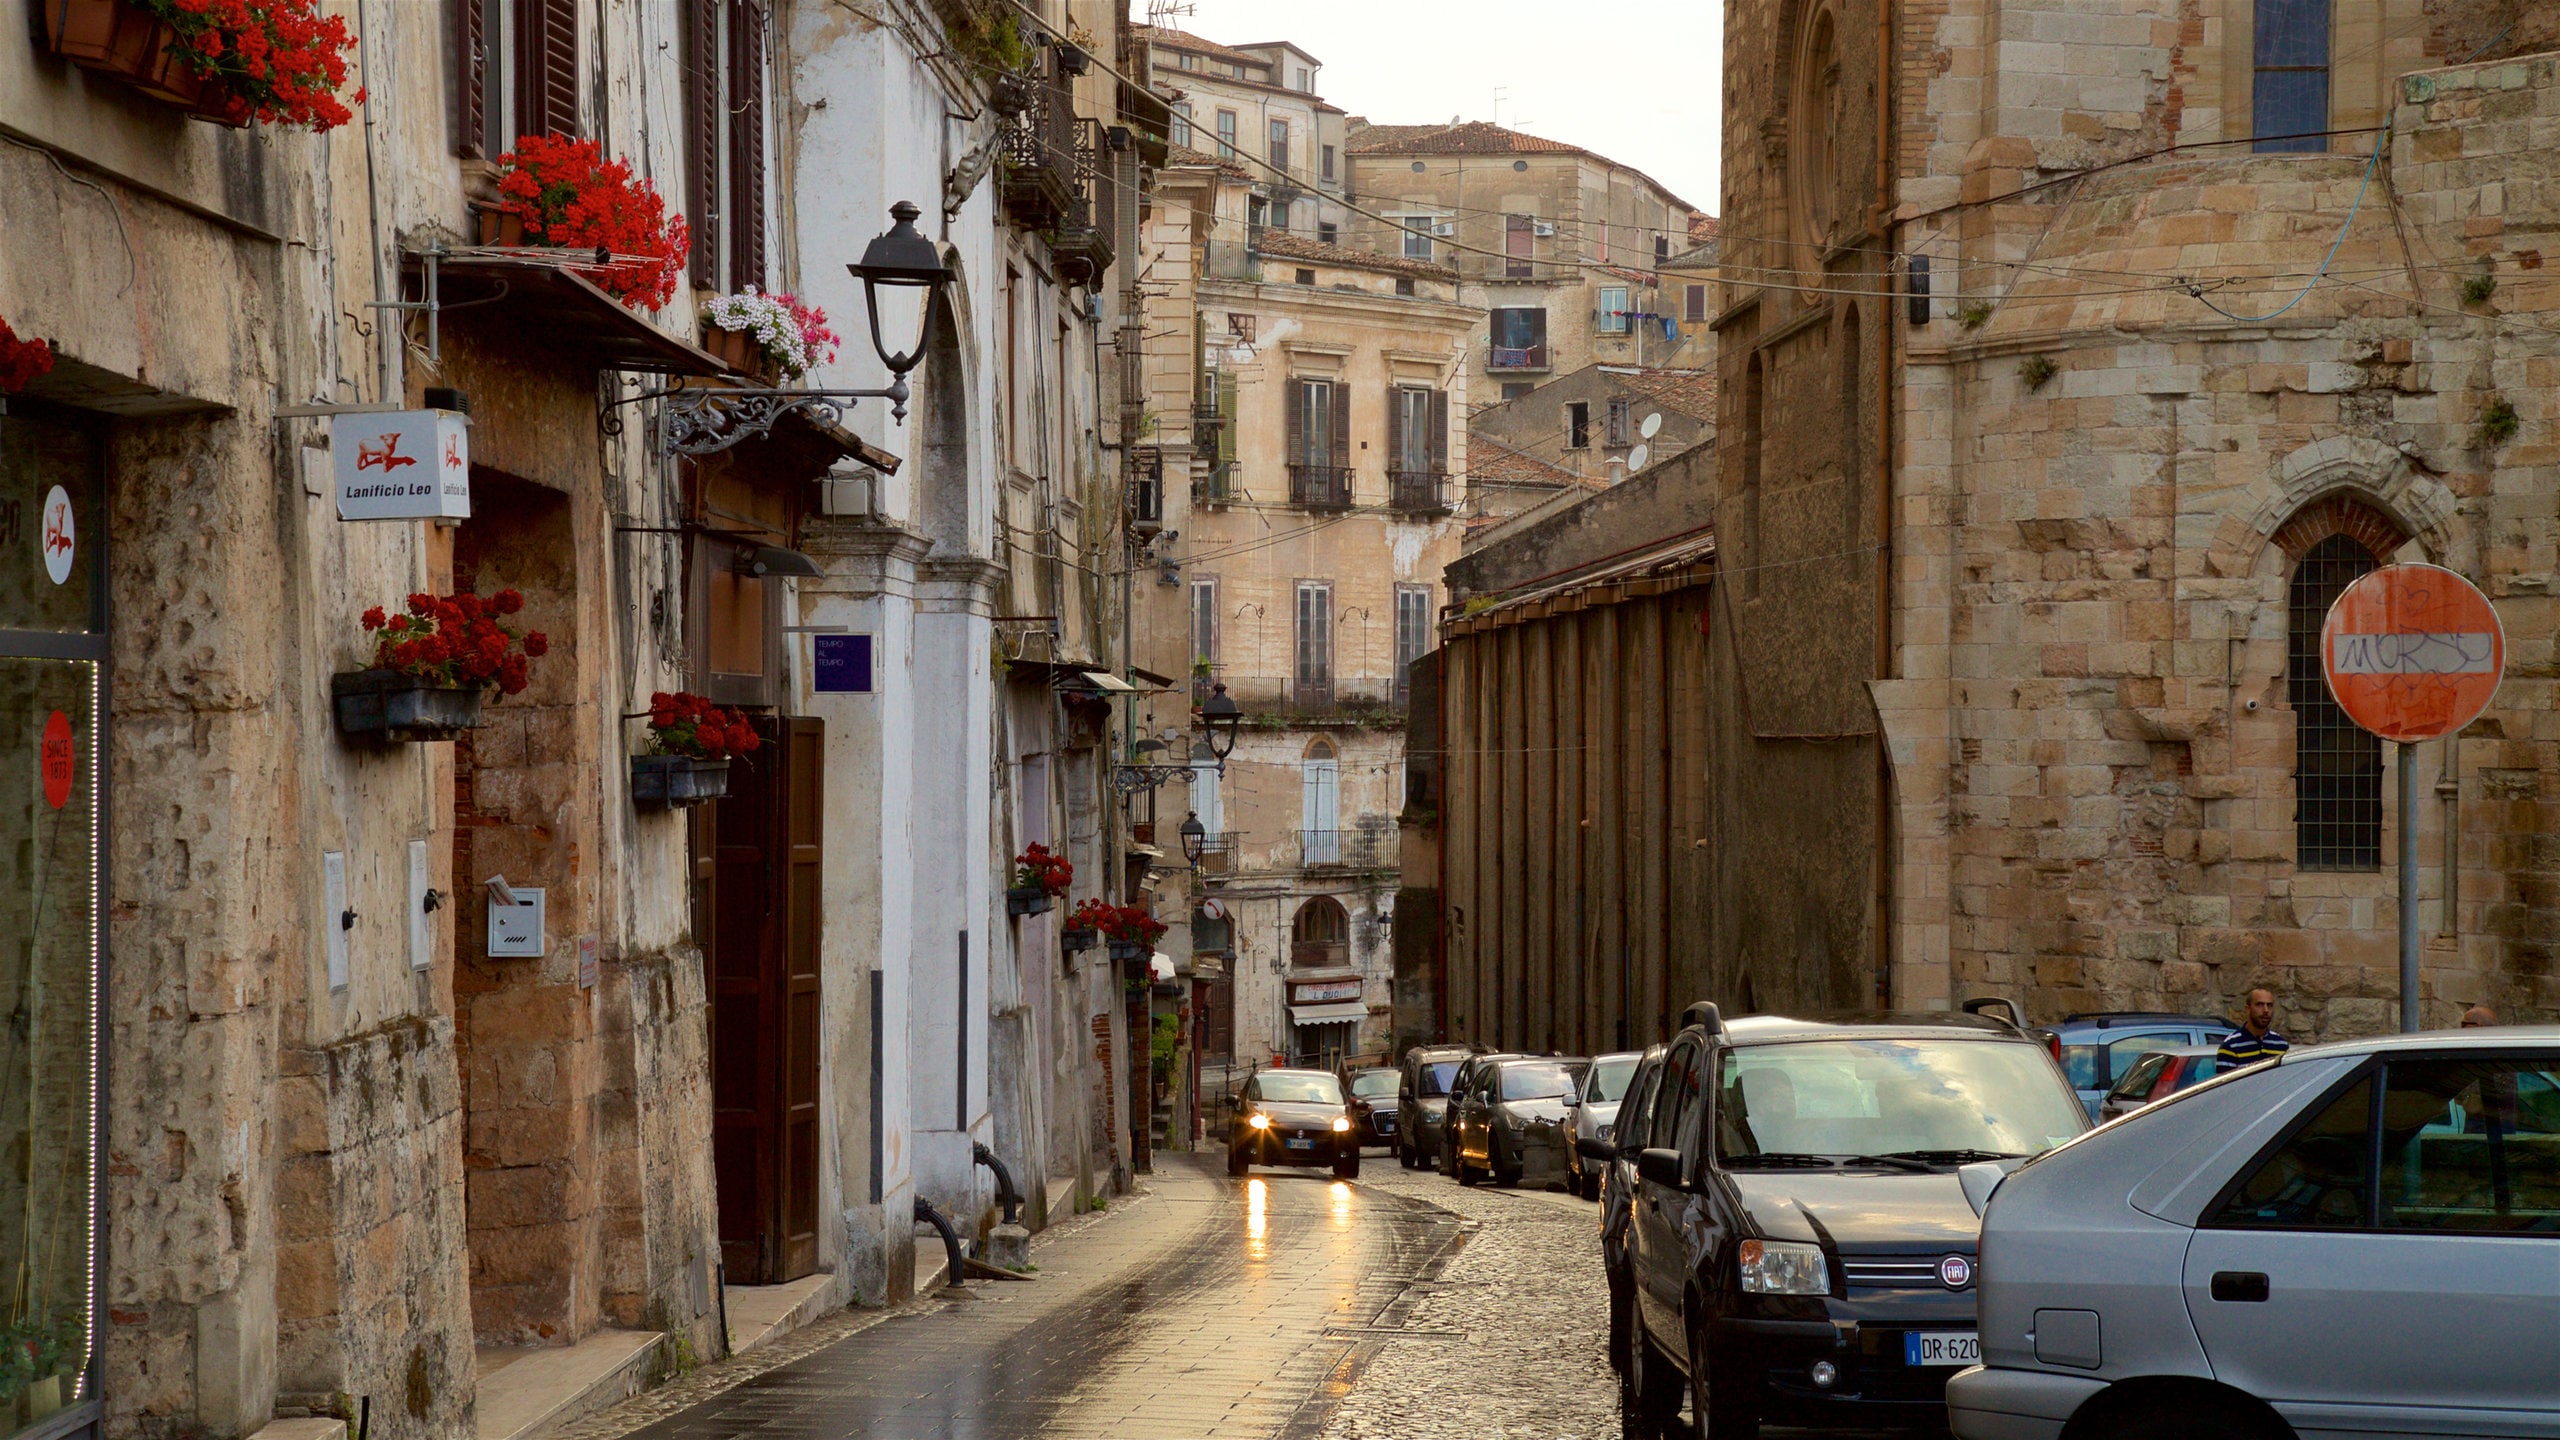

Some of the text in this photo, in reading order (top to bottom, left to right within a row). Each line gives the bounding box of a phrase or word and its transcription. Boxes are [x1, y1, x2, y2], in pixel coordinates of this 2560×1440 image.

[346, 483, 431, 498] Lanificio Leo
[818, 640, 844, 648] TEMPO
[818, 659, 844, 667] TEMPO
[47, 739, 68, 758] SINCE
[50, 761, 67, 779] 1873
[1946, 1265, 1964, 1279] FIAT
